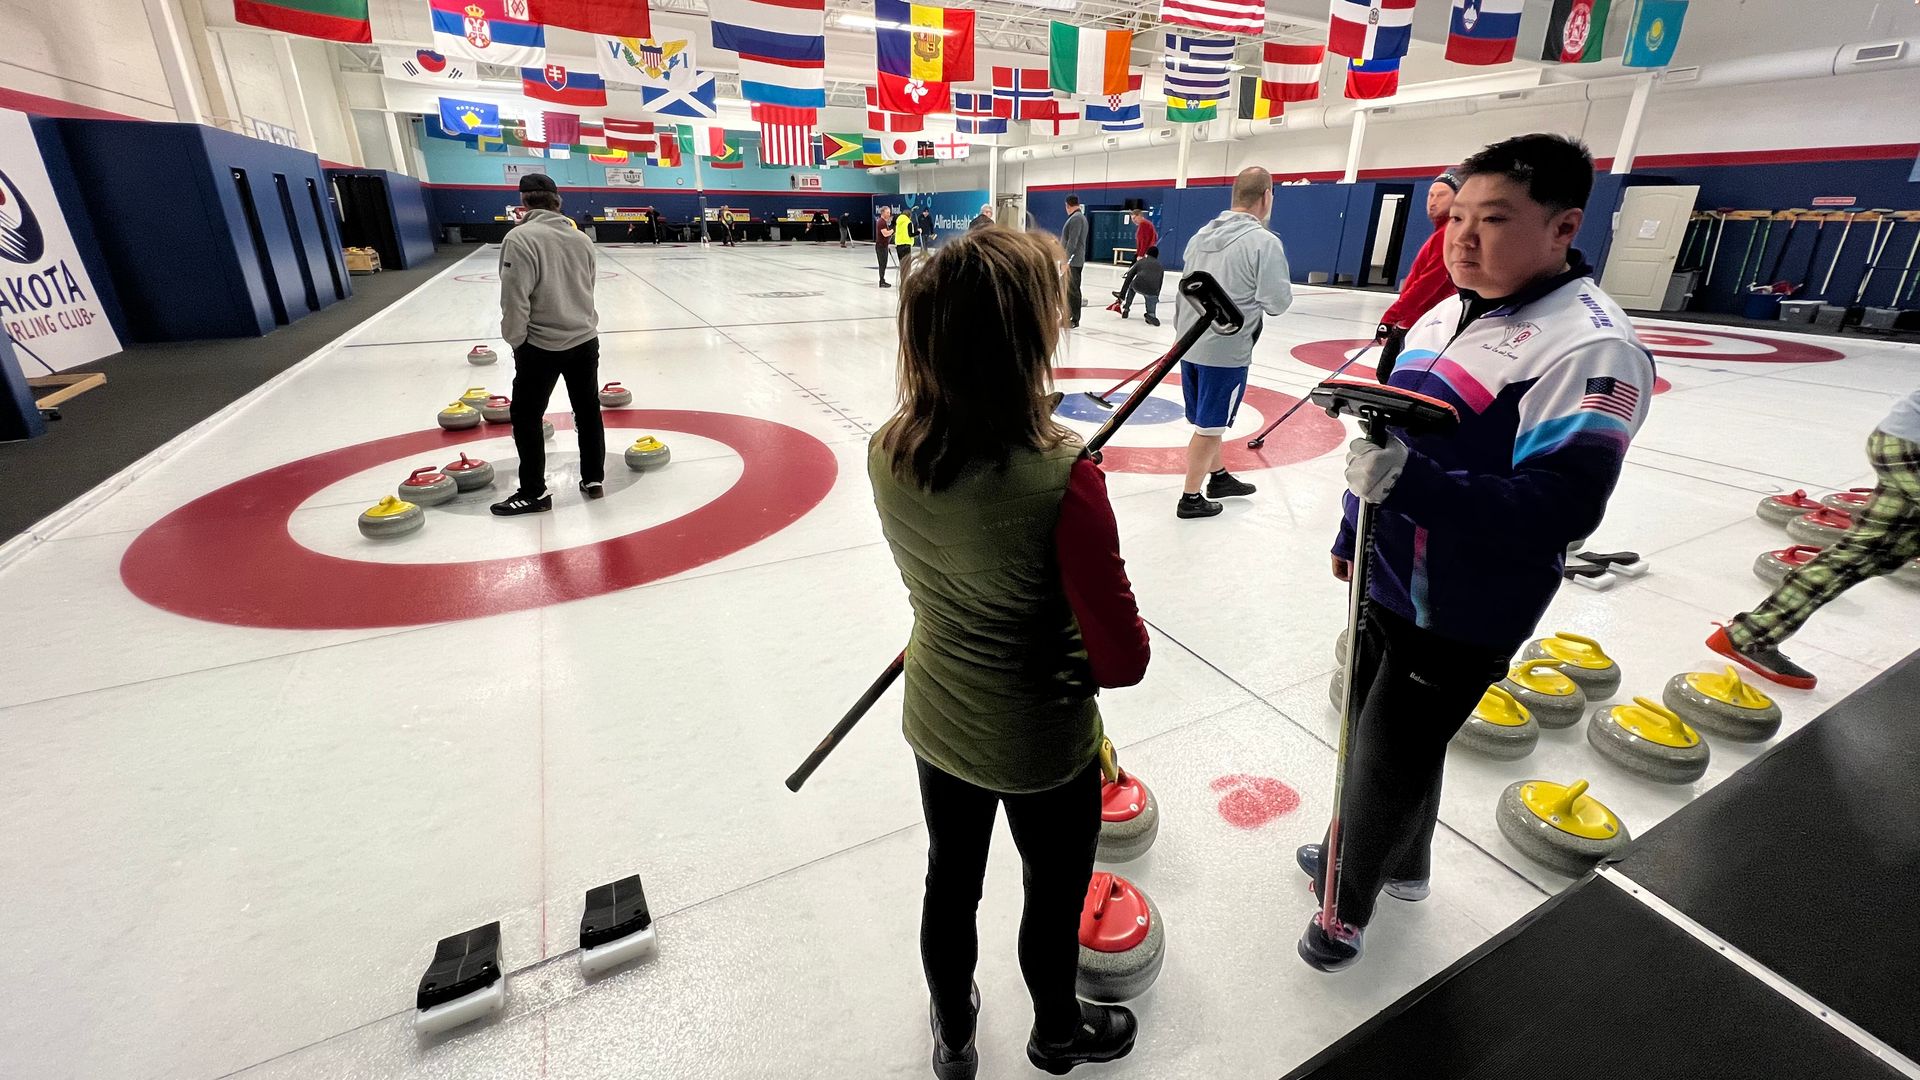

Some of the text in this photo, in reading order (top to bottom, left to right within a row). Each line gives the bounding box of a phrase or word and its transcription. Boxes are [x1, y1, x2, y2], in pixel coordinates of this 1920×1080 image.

[608, 41, 621, 59] V
[934, 214, 951, 229] Allina
[0, 259, 86, 315] AKOTA
[5, 308, 91, 341] RLING CLUB
